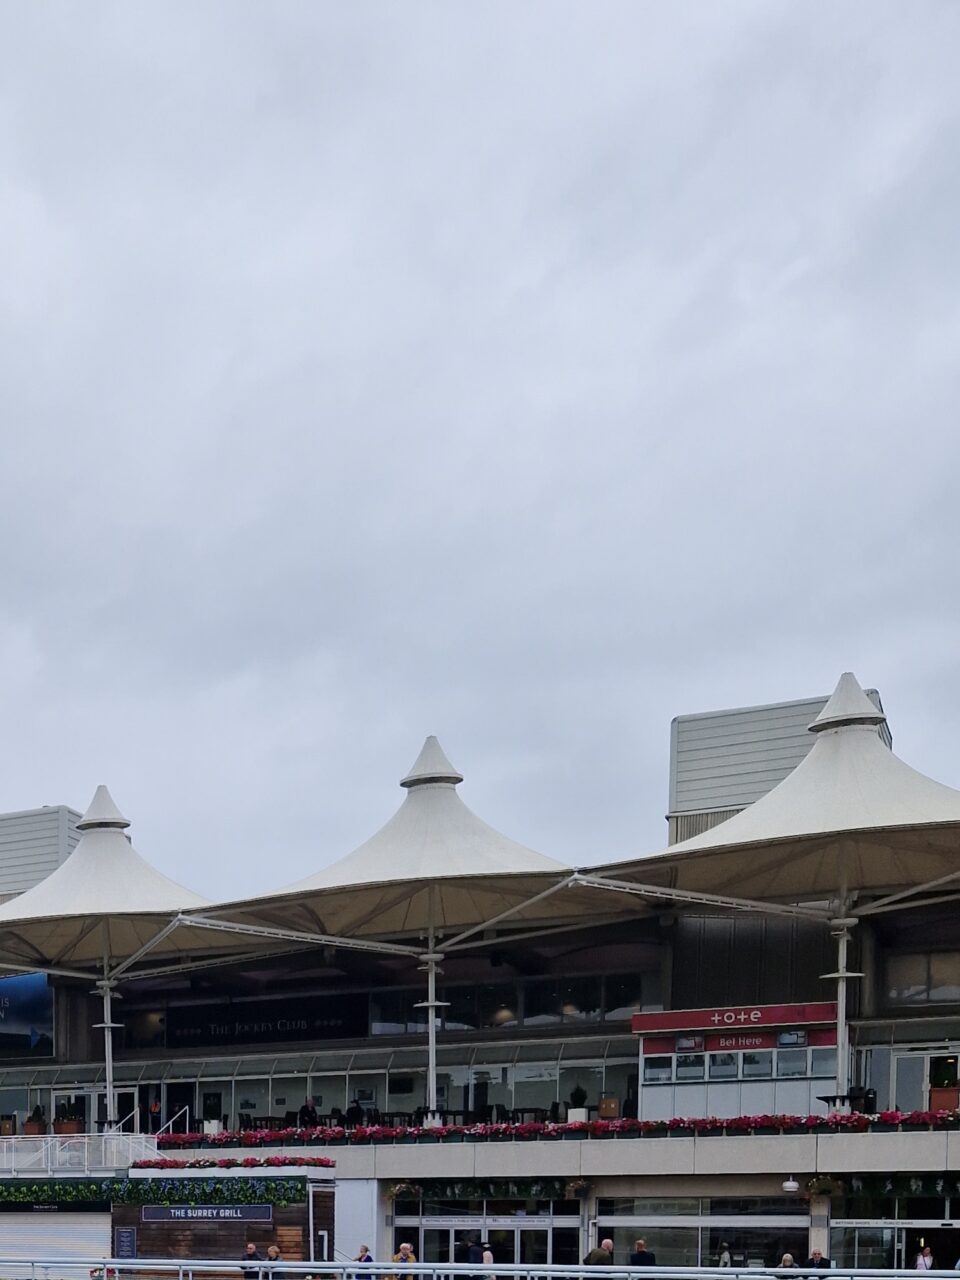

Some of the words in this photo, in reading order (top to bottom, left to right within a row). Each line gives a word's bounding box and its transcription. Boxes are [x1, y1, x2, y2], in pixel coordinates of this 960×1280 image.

[1, 997, 10, 1008] IS
[711, 1010, 762, 1024] tote
[720, 1037, 736, 1047] Bet
[738, 1035, 762, 1046] Here
[170, 1209, 185, 1217] THE
[187, 1209, 217, 1217] SURREY
[219, 1209, 242, 1217] GRILL
